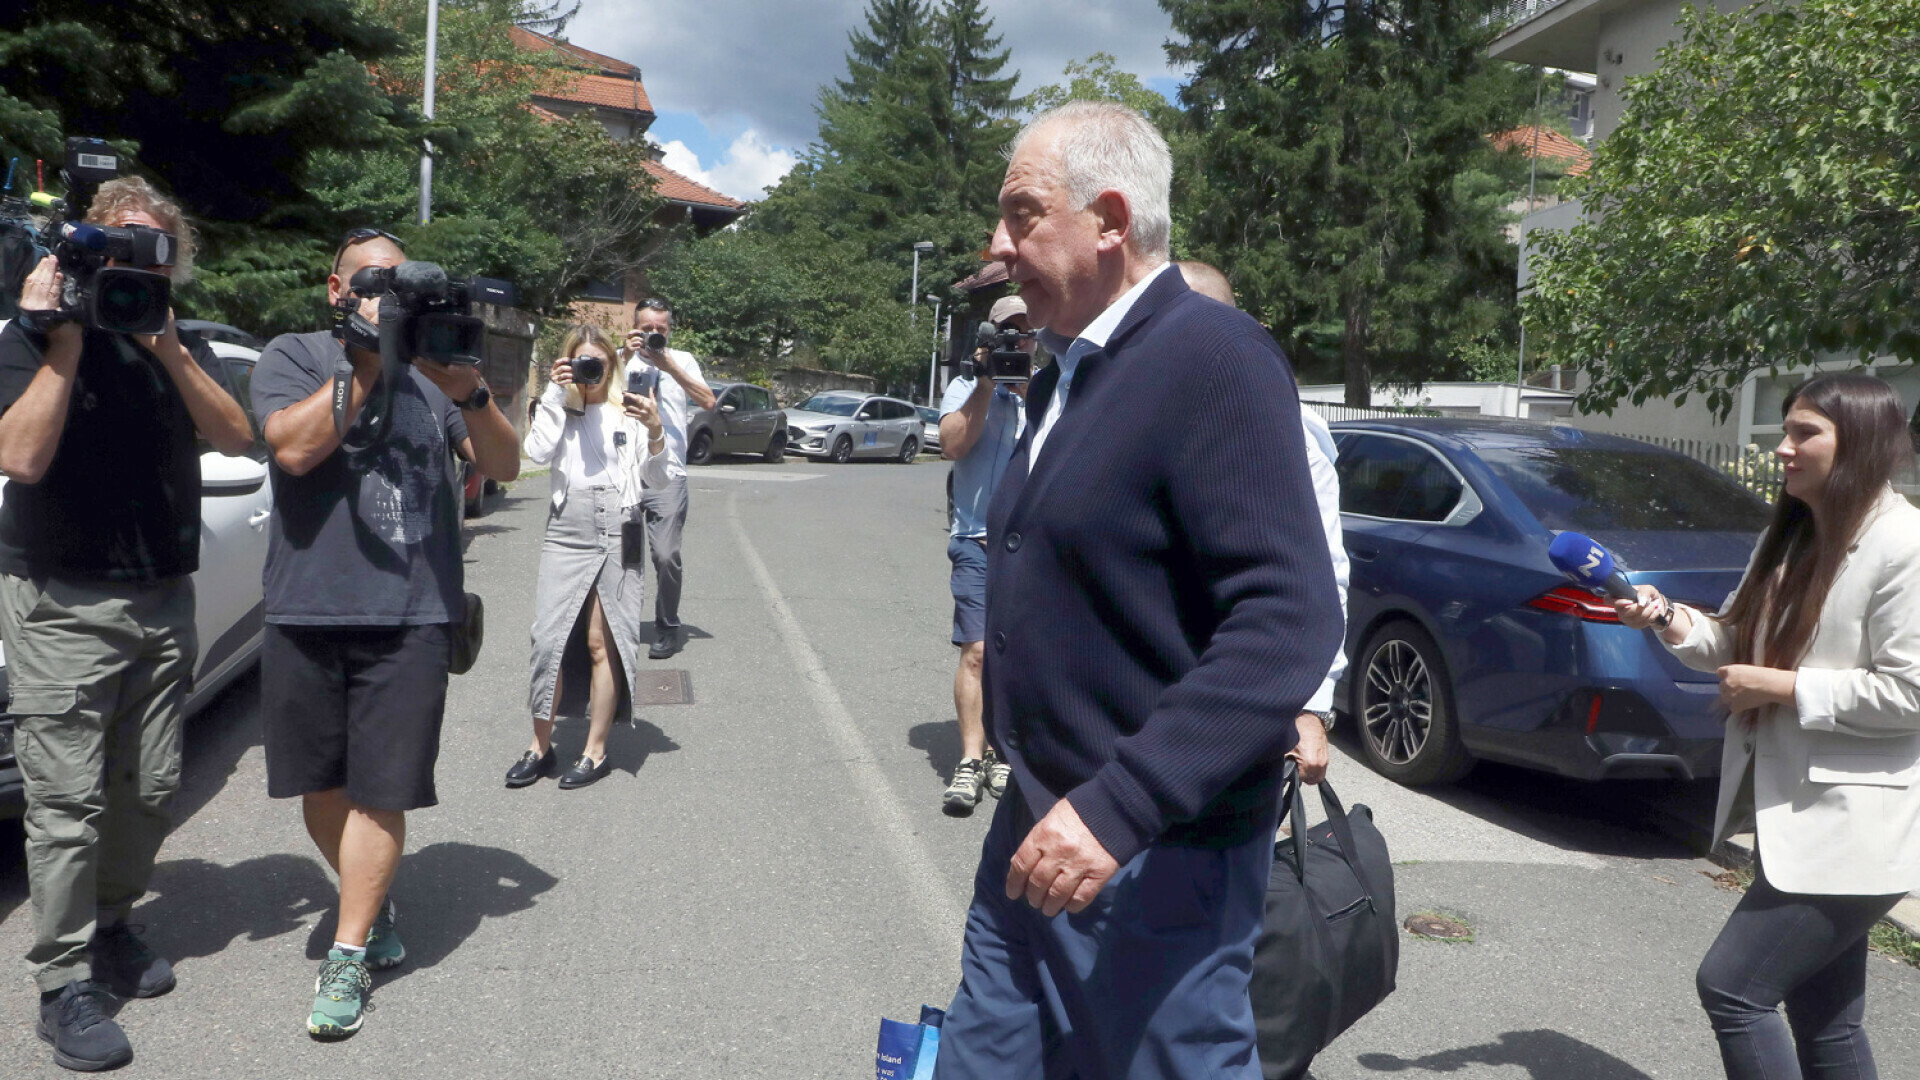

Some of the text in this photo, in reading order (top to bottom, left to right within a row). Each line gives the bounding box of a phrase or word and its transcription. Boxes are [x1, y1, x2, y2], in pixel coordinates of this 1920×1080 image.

[350, 322, 368, 337] SONY
[336, 380, 345, 410] SONY
[1578, 546, 1604, 578] N1
[881, 1052, 902, 1065] Island
